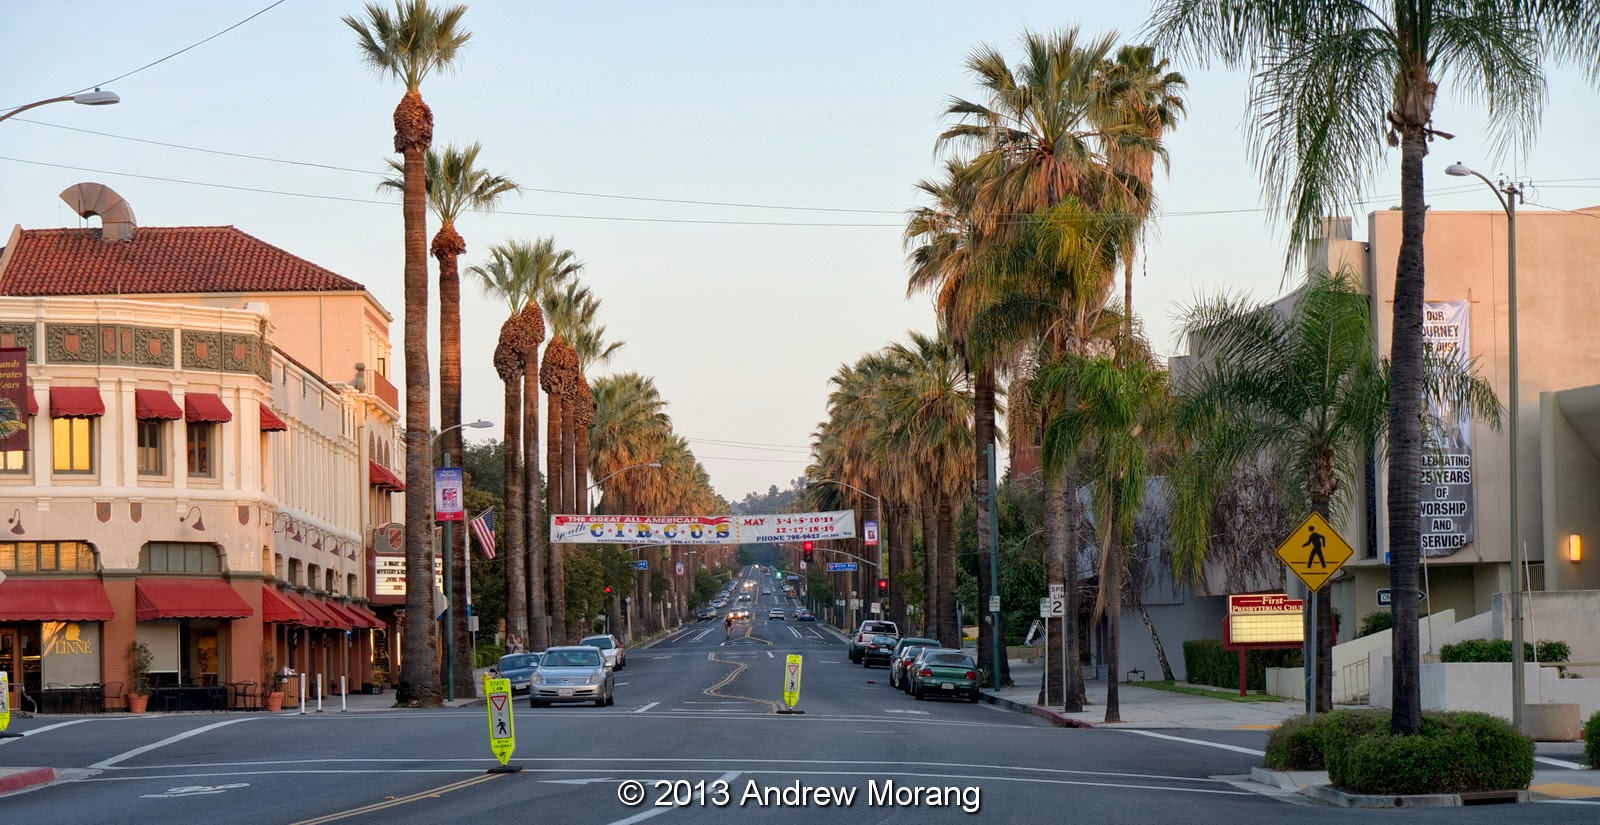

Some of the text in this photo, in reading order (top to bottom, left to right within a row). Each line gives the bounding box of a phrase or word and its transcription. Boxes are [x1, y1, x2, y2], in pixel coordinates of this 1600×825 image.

[1426, 310, 1444, 321] OUR
[1422, 325, 1459, 338] OURNEY
[0, 359, 20, 368] ands
[1420, 470, 1470, 483] 25 YEARS
[1436, 487, 1448, 498] OF
[743, 518, 765, 526] MAY
[1432, 519, 1452, 531] AND
[1422, 534, 1465, 548] SERVICE
[1261, 596, 1284, 605] First
[1053, 601, 1062, 613] 2
